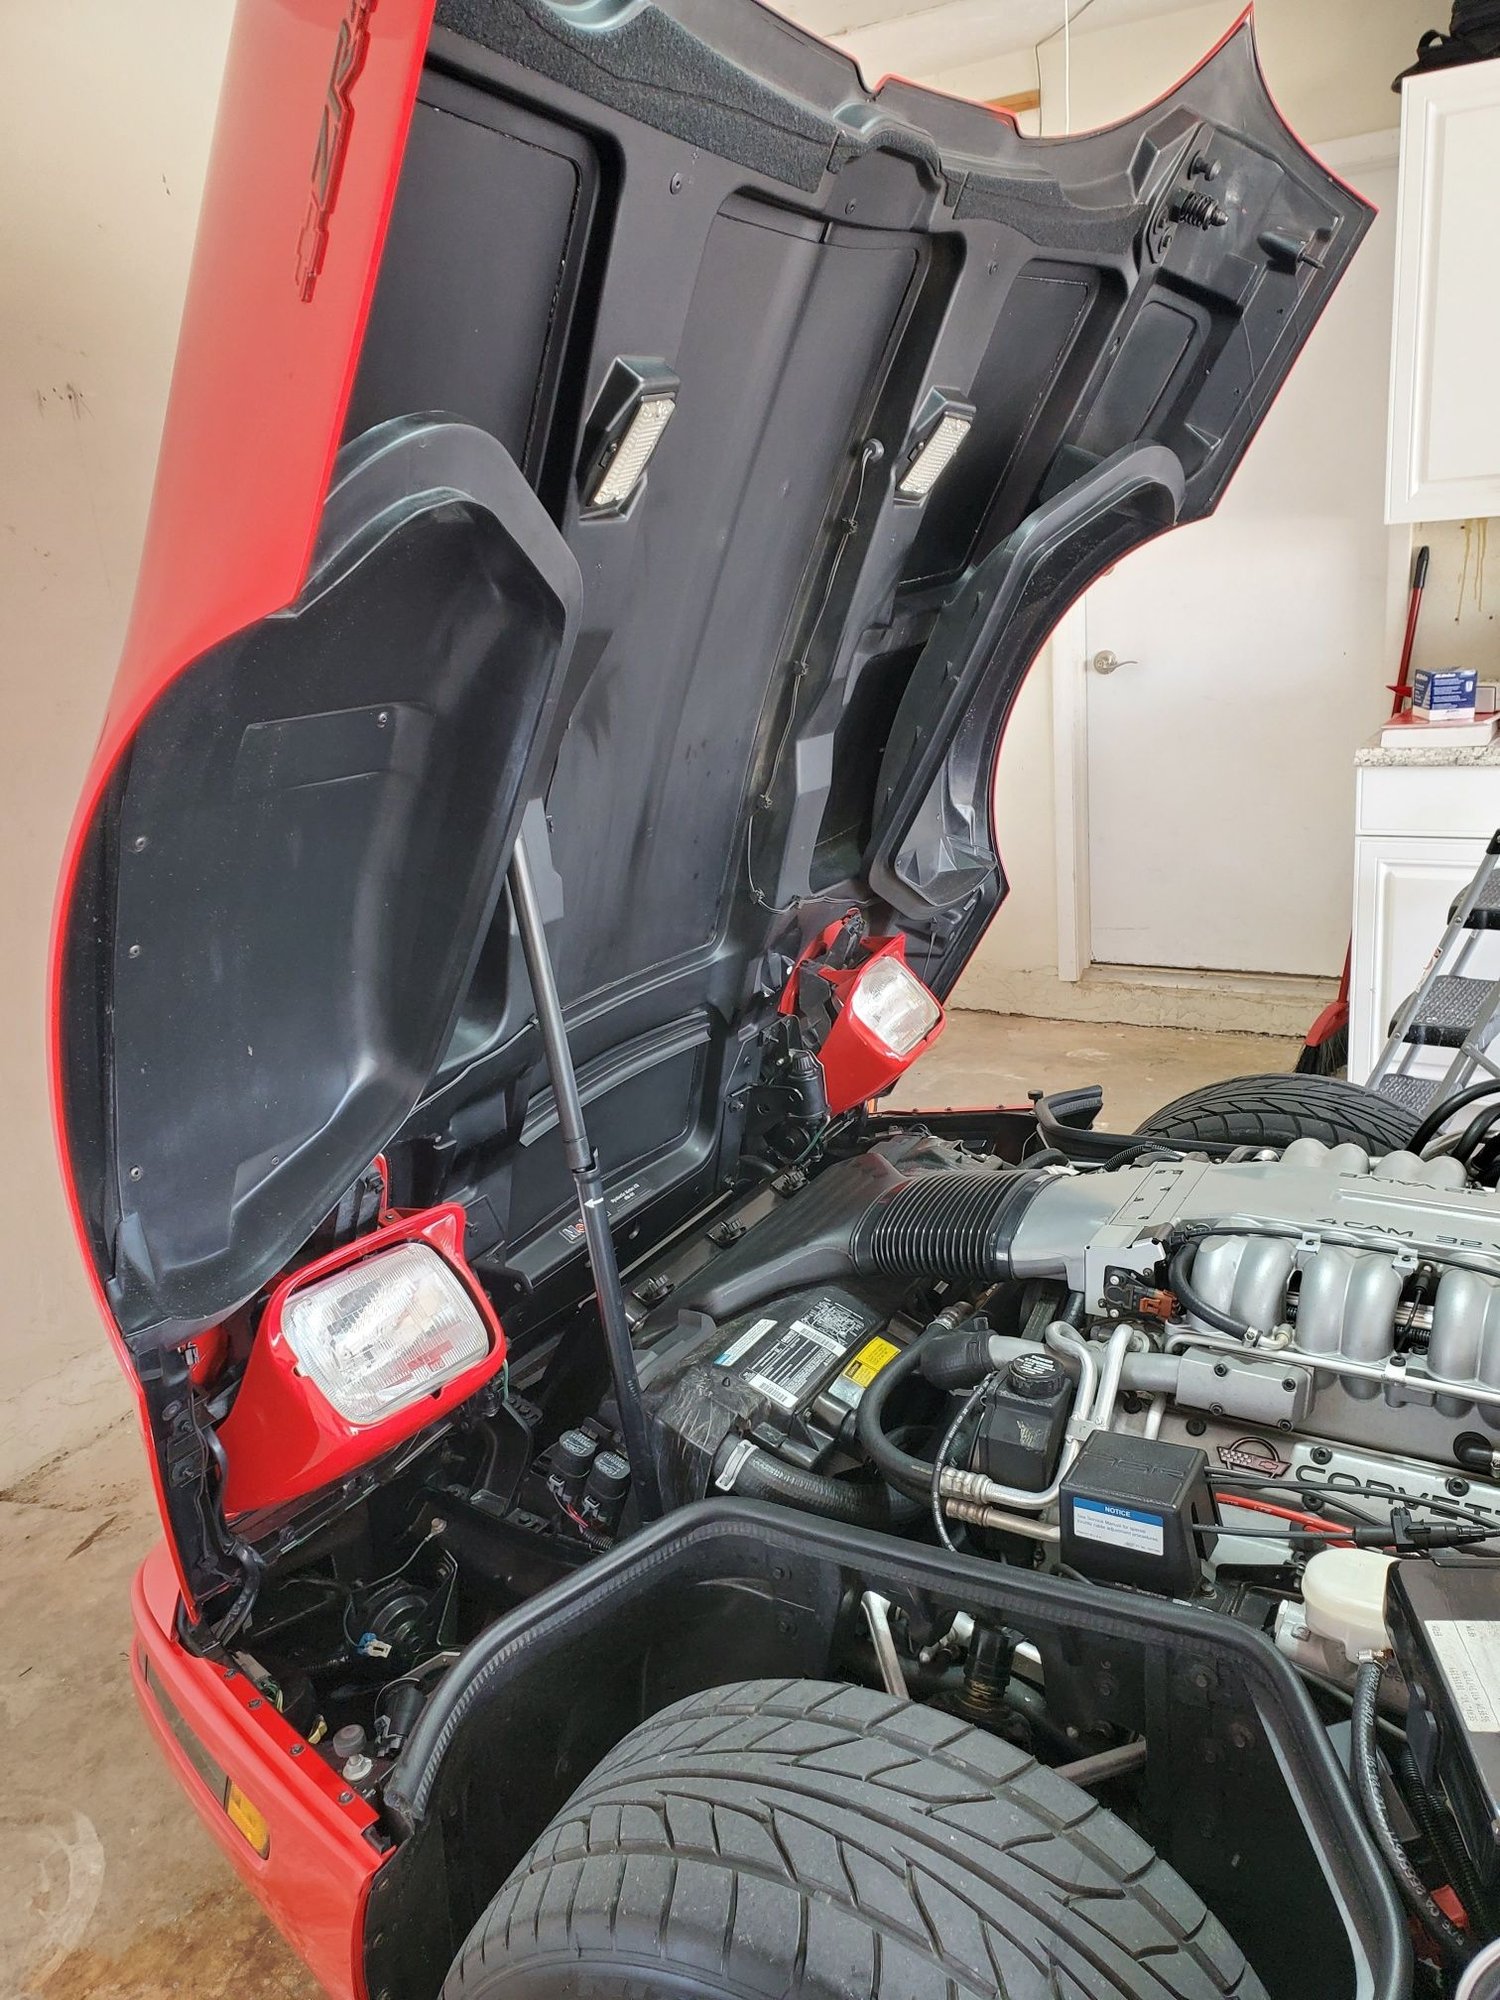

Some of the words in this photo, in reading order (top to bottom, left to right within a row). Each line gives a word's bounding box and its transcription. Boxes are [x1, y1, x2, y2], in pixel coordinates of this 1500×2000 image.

[1435, 1235, 1483, 1249] 32
[1295, 1464, 1500, 1524] CORVET
[1104, 1506, 1131, 1518] NOTICE
